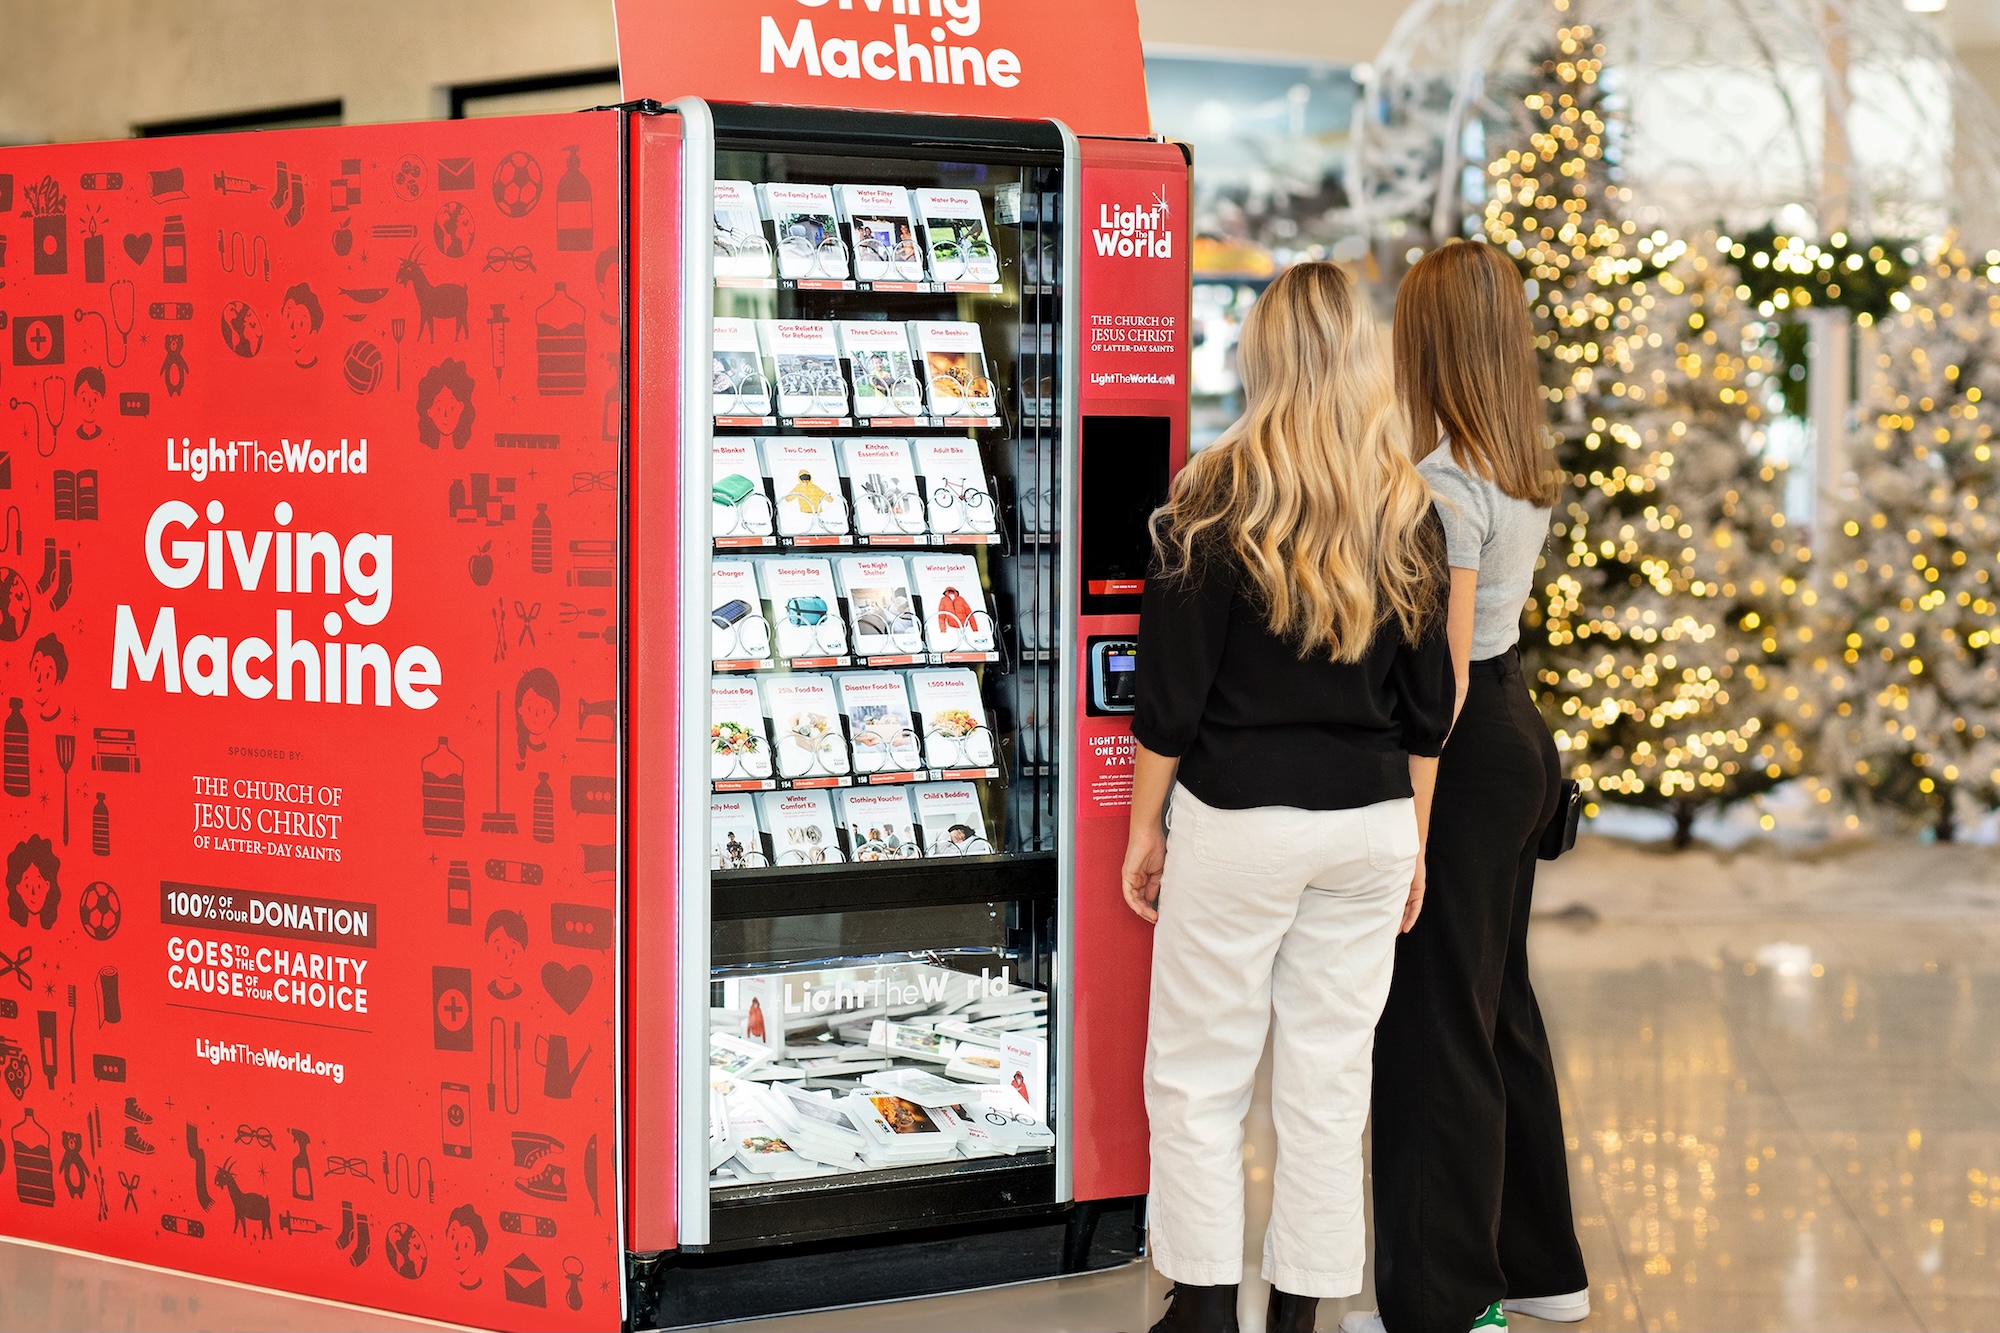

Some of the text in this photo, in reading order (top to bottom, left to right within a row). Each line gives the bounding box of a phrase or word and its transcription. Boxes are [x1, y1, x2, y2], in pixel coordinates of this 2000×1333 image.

[760, 16, 1021, 88] Machine
[774, 190, 787, 198] One
[788, 192, 808, 200] Family
[930, 196, 949, 204] Water
[872, 197, 892, 205] Family
[1100, 203, 1160, 237] Light
[1136, 230, 1148, 239] The
[1092, 230, 1172, 258] World
[1091, 316, 1175, 326] THE CHURCH OF
[793, 332, 822, 340] Refugees
[1091, 328, 1175, 344] JESUS CHRIST
[858, 450, 889, 458] Essentials
[167, 439, 367, 482] LightTheWorld
[782, 538, 793, 546] 134
[145, 500, 392, 625] Giving
[872, 562, 888, 570] Night
[718, 570, 744, 578] Charger
[778, 568, 820, 576] Sleeping Bag
[111, 605, 442, 709] Machine
[780, 660, 790, 668] 144
[740, 688, 754, 696] Bag
[845, 684, 871, 692] Disaster
[889, 682, 900, 690] Box
[1090, 737, 1115, 746] LIGHT
[228, 746, 304, 760] SPONSORED BY:
[1095, 747, 1114, 756] ONE
[1106, 757, 1117, 766] AT
[1119, 757, 1126, 765] A
[192, 776, 342, 806] THE CHURCH OF
[924, 791, 970, 800] Child's Bedding
[850, 796, 877, 804] Clothing
[193, 803, 342, 840] JESUS CHRIST
[194, 835, 342, 862] OF LATTER-DAY SAINTS
[168, 891, 368, 937] 100% OF YOUR DONATION
[168, 936, 368, 985] GOES TO THE CHARITY
[168, 964, 368, 1014] CAUSE OF YOUR CHOICE
[196, 1038, 344, 1084] LightTheWorld.org
